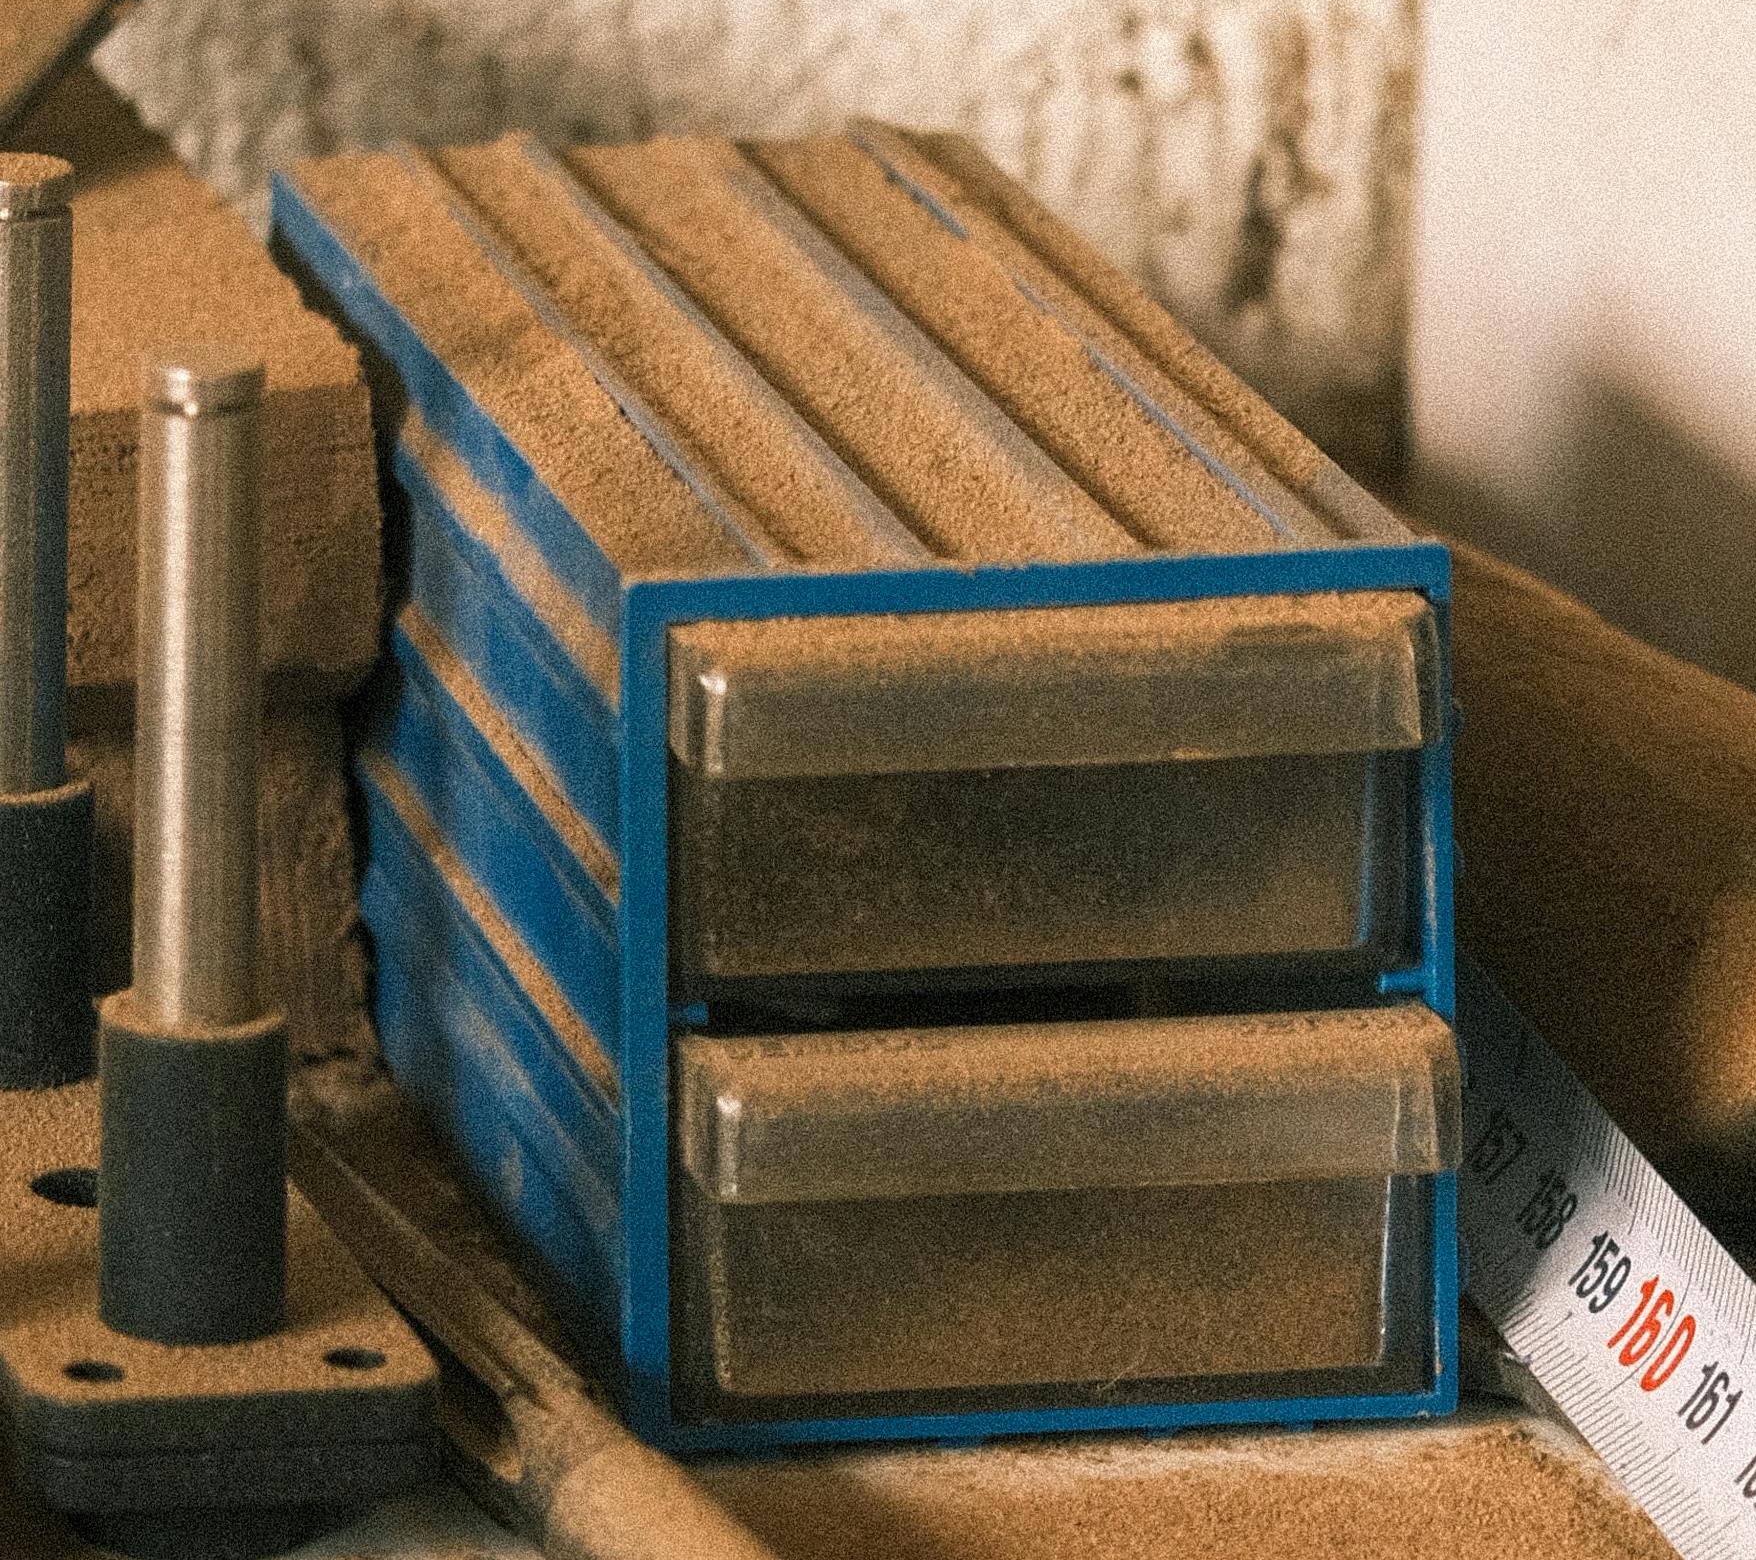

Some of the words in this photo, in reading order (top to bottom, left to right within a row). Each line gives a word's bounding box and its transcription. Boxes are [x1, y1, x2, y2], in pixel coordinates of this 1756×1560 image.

[1515, 1167, 1578, 1249] 158
[1568, 1230, 1632, 1314] 159
[1607, 1274, 1696, 1393] 160
[1678, 1361, 1745, 1445] 161
